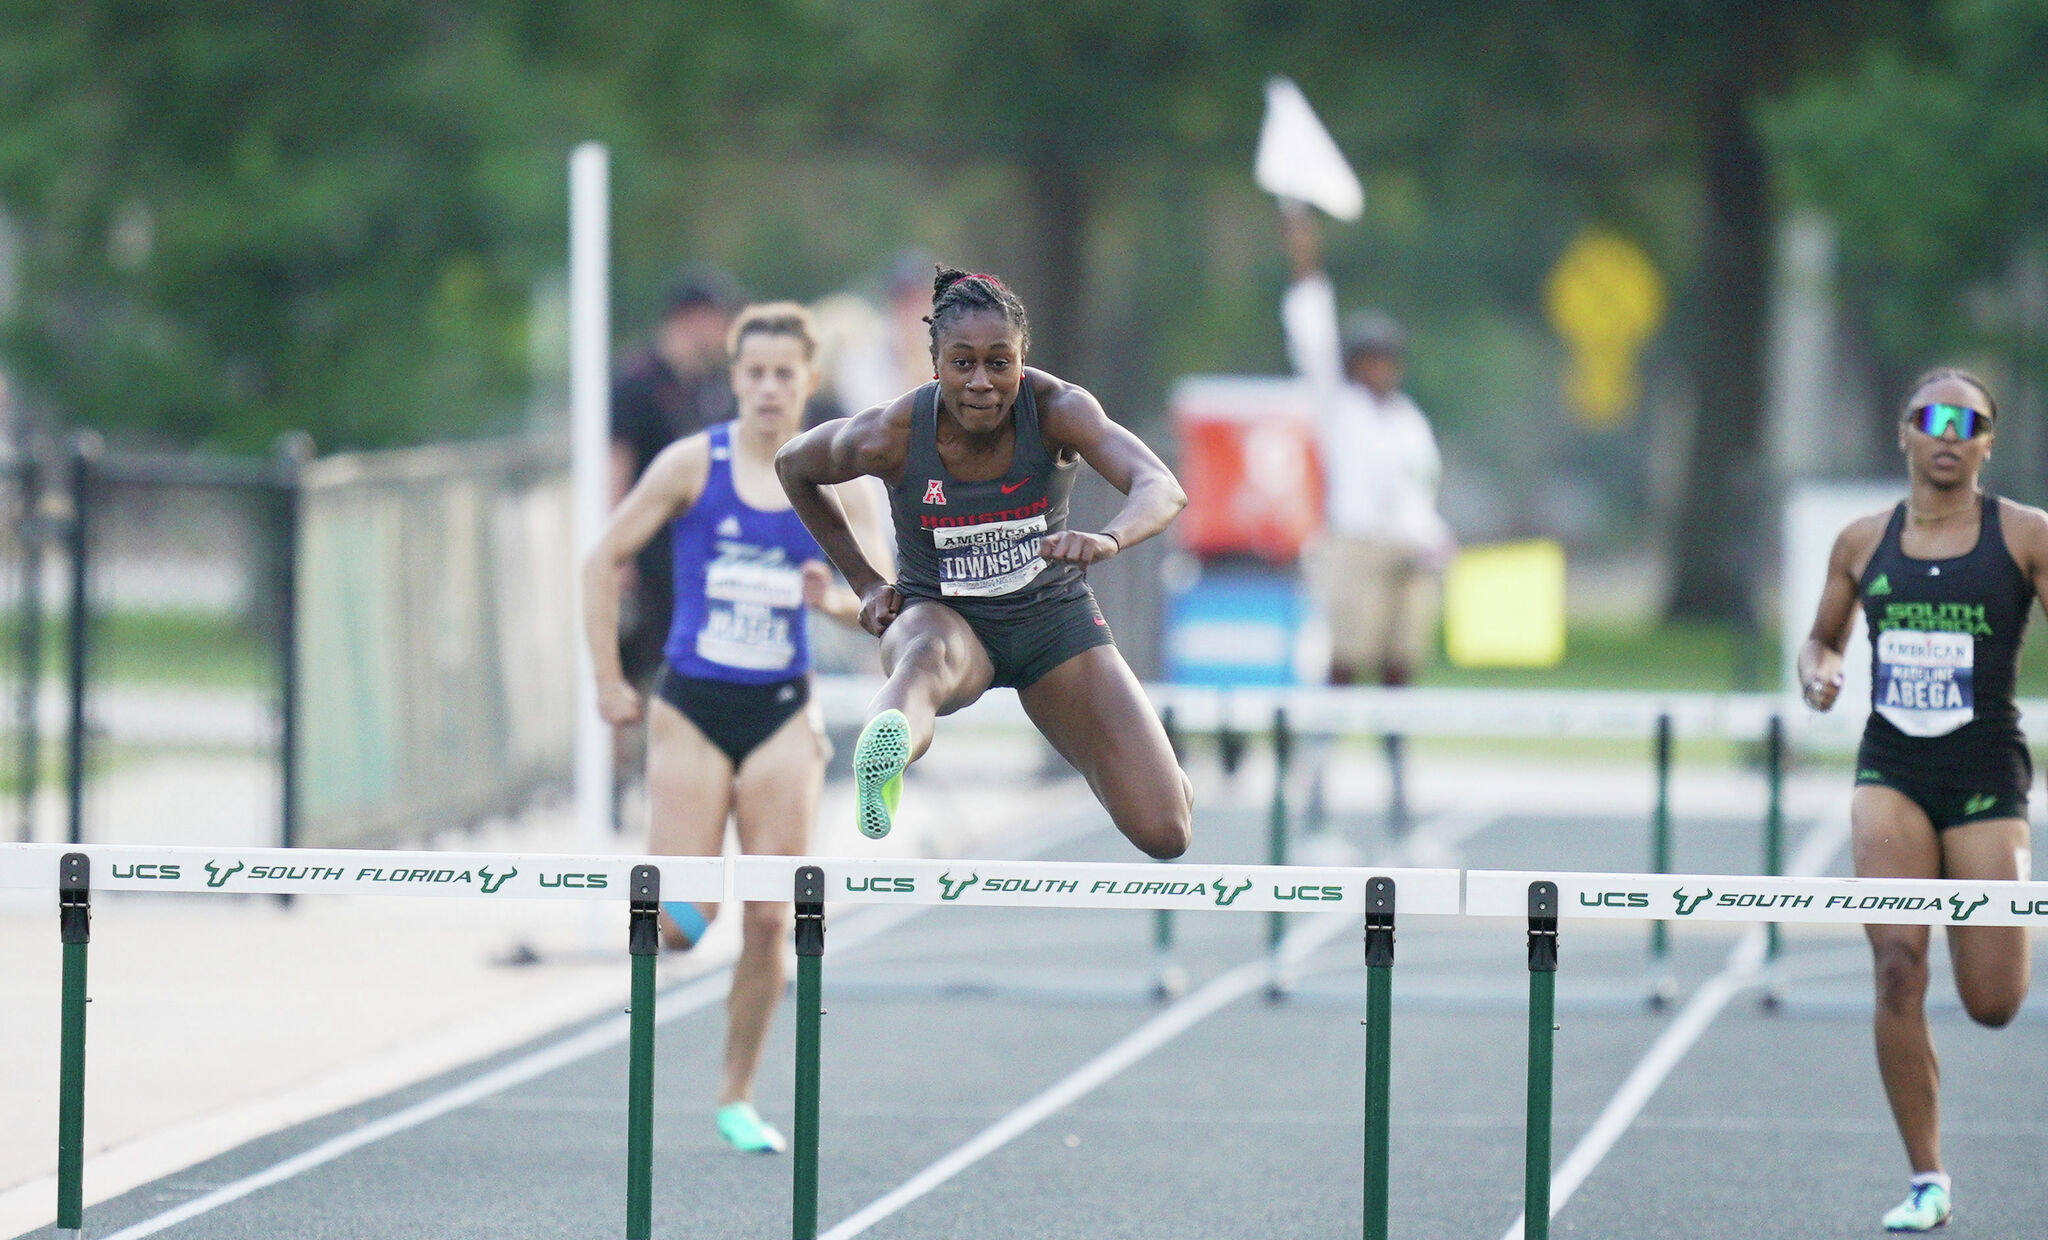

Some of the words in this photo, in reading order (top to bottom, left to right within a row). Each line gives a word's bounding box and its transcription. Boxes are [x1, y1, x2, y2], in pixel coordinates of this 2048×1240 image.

[920, 496, 1048, 529] HOUSTON
[944, 525, 1040, 546] AMERICAN
[942, 537, 1041, 579] TOWNSEND
[1886, 602, 1985, 619] SOUTH
[1888, 642, 1965, 658] AMERICAN
[1886, 680, 1963, 709] ABEGA
[112, 863, 181, 880] UCS
[247, 866, 345, 881] SOUTH
[355, 868, 472, 883] FLORIDA
[539, 873, 608, 889] UCS
[846, 876, 915, 893] UCS
[981, 878, 1079, 893] SOUTH
[1090, 880, 1206, 896] FLORIDA
[1274, 885, 1343, 901] UCS
[1580, 891, 1649, 908] UCS
[1716, 893, 1814, 908] SOUTH
[1825, 895, 1943, 911] FLORIDA
